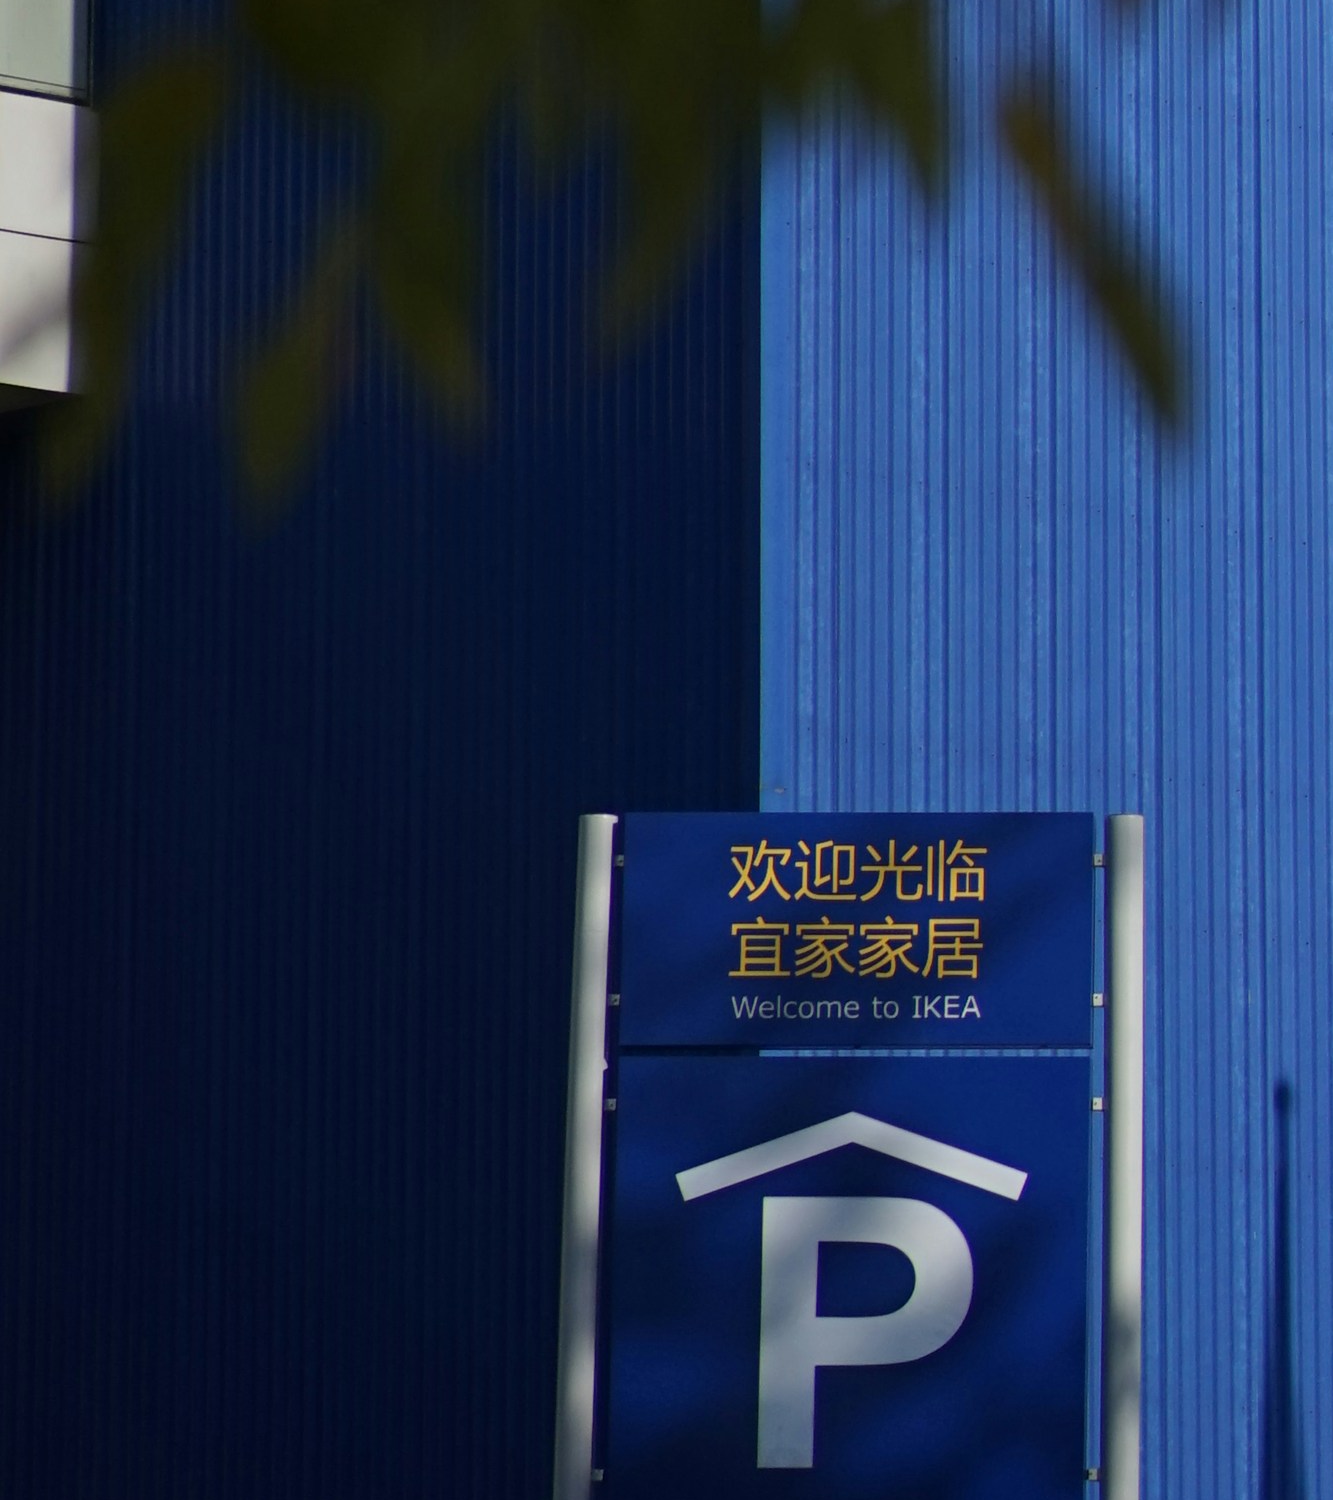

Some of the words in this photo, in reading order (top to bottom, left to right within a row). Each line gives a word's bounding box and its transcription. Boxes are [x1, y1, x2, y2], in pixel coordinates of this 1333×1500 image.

[728, 839, 988, 902] 欢迎光临
[728, 915, 984, 979] 宜家家居
[731, 995, 860, 1019] Welcome
[872, 996, 900, 1019] to
[912, 995, 981, 1019] IKEA
[757, 1196, 974, 1469] P
